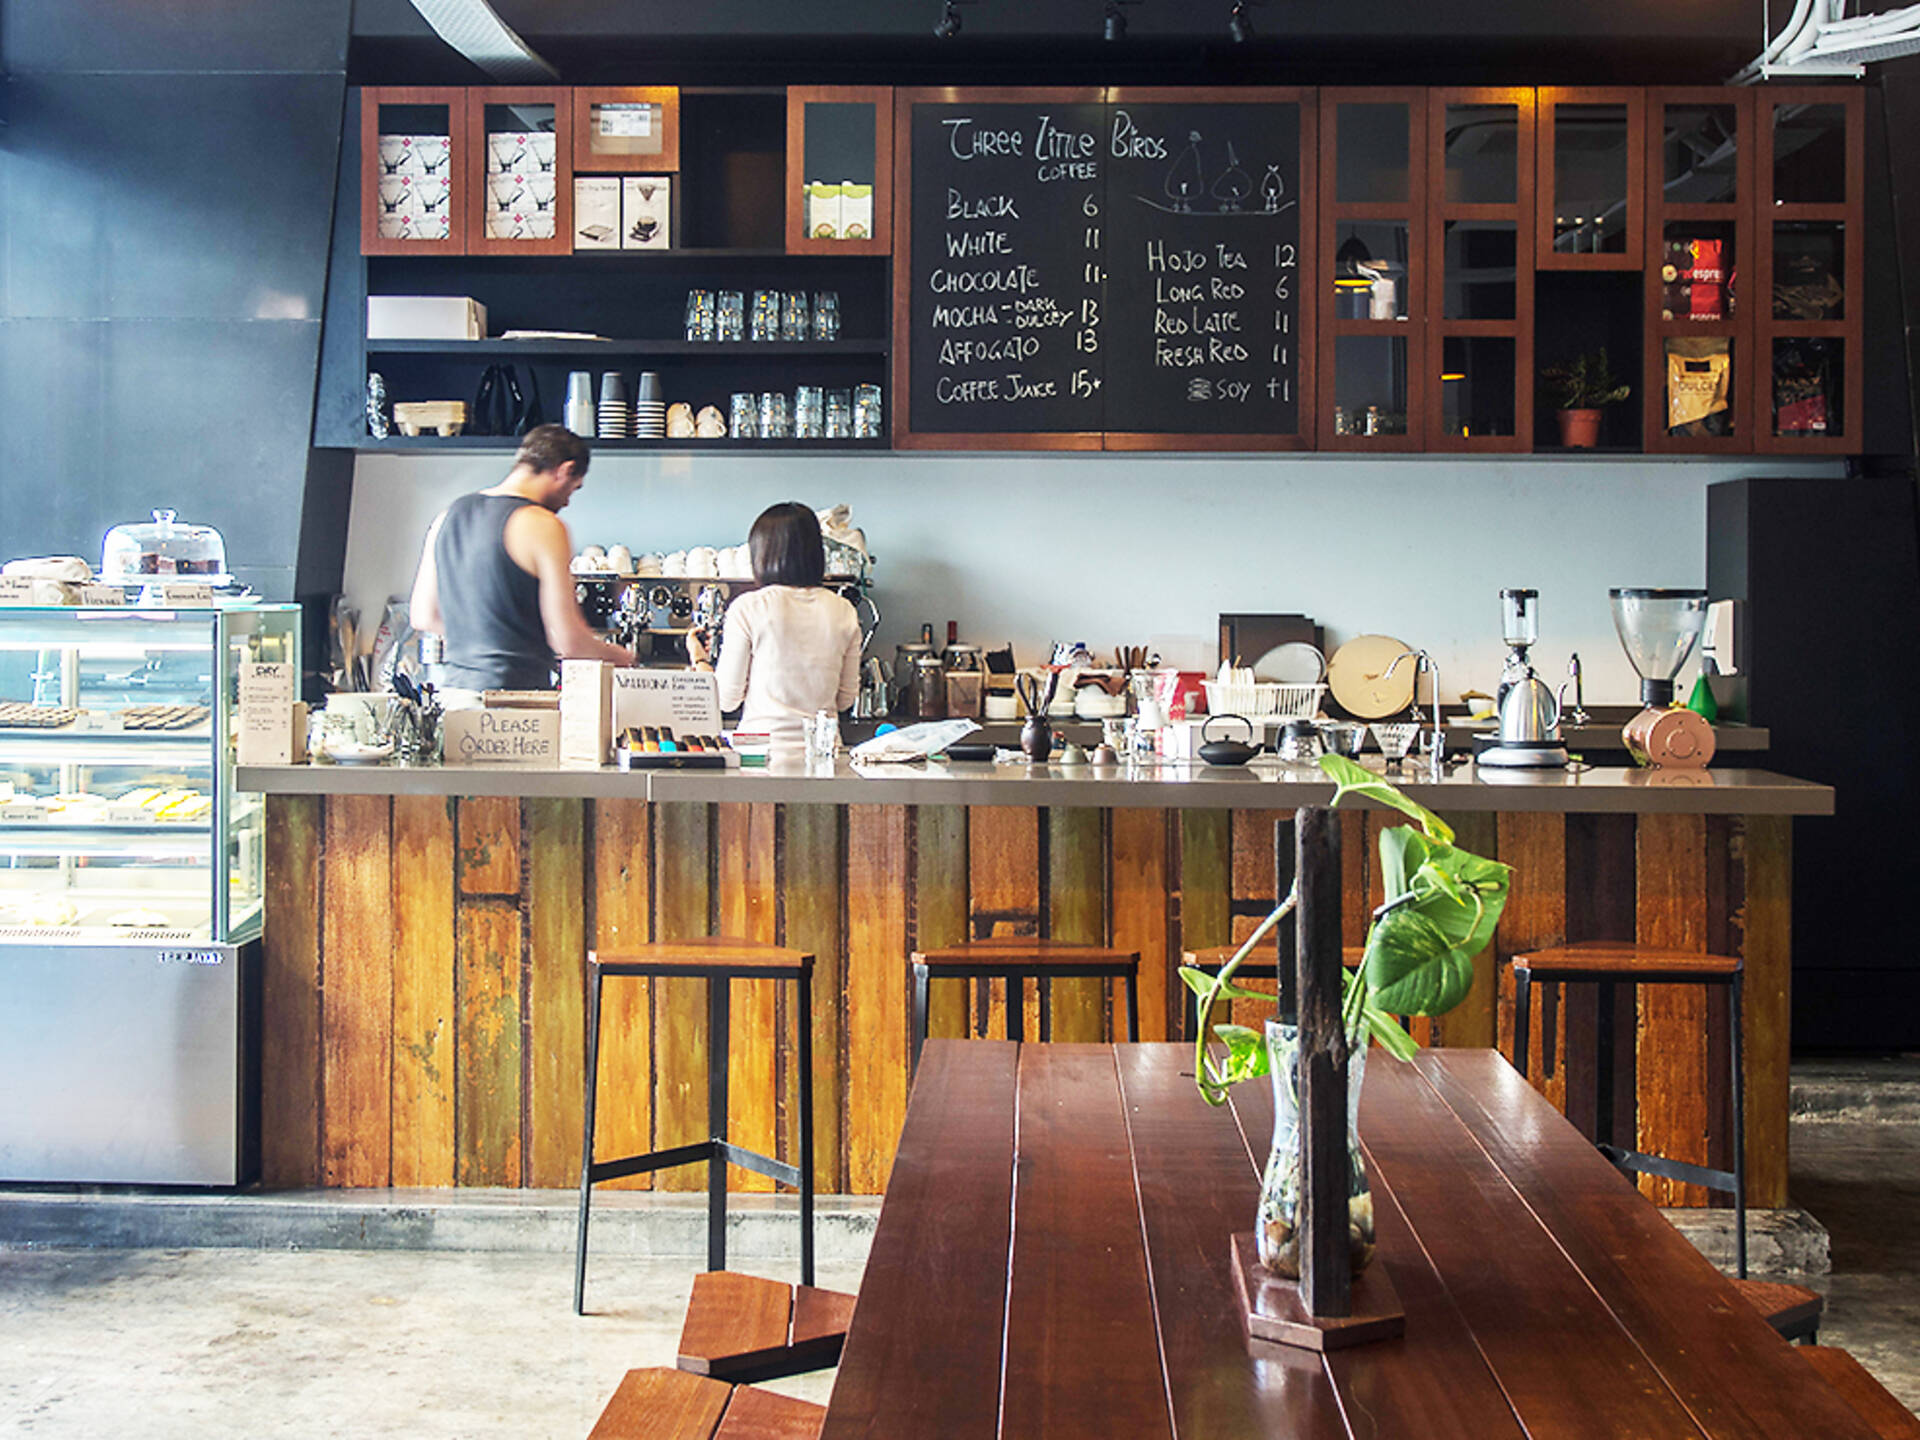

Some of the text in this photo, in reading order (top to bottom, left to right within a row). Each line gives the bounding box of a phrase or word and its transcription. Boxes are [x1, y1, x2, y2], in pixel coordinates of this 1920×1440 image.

[1038, 162, 1097, 182] COFFEE
[946, 187, 1099, 219] BLACK 6
[946, 227, 1100, 258] WHITE 11
[1147, 239, 1207, 273] HOJO
[1275, 244, 1296, 268] 12
[930, 264, 1040, 294] CHOCOLATE
[1156, 277, 1205, 303] LONG
[1275, 275, 1289, 300] 6
[932, 303, 999, 328] MOCHA
[1081, 299, 1100, 327] 13
[1275, 309, 1289, 334] 11
[938, 328, 1099, 365] AFFOGATO 13
[1273, 343, 1287, 365] 11
[936, 376, 999, 403] COFFEE
[1216, 379, 1251, 402] SOY
[480, 711, 540, 734] PLEASE
[460, 733, 551, 756] ORDER HERE
